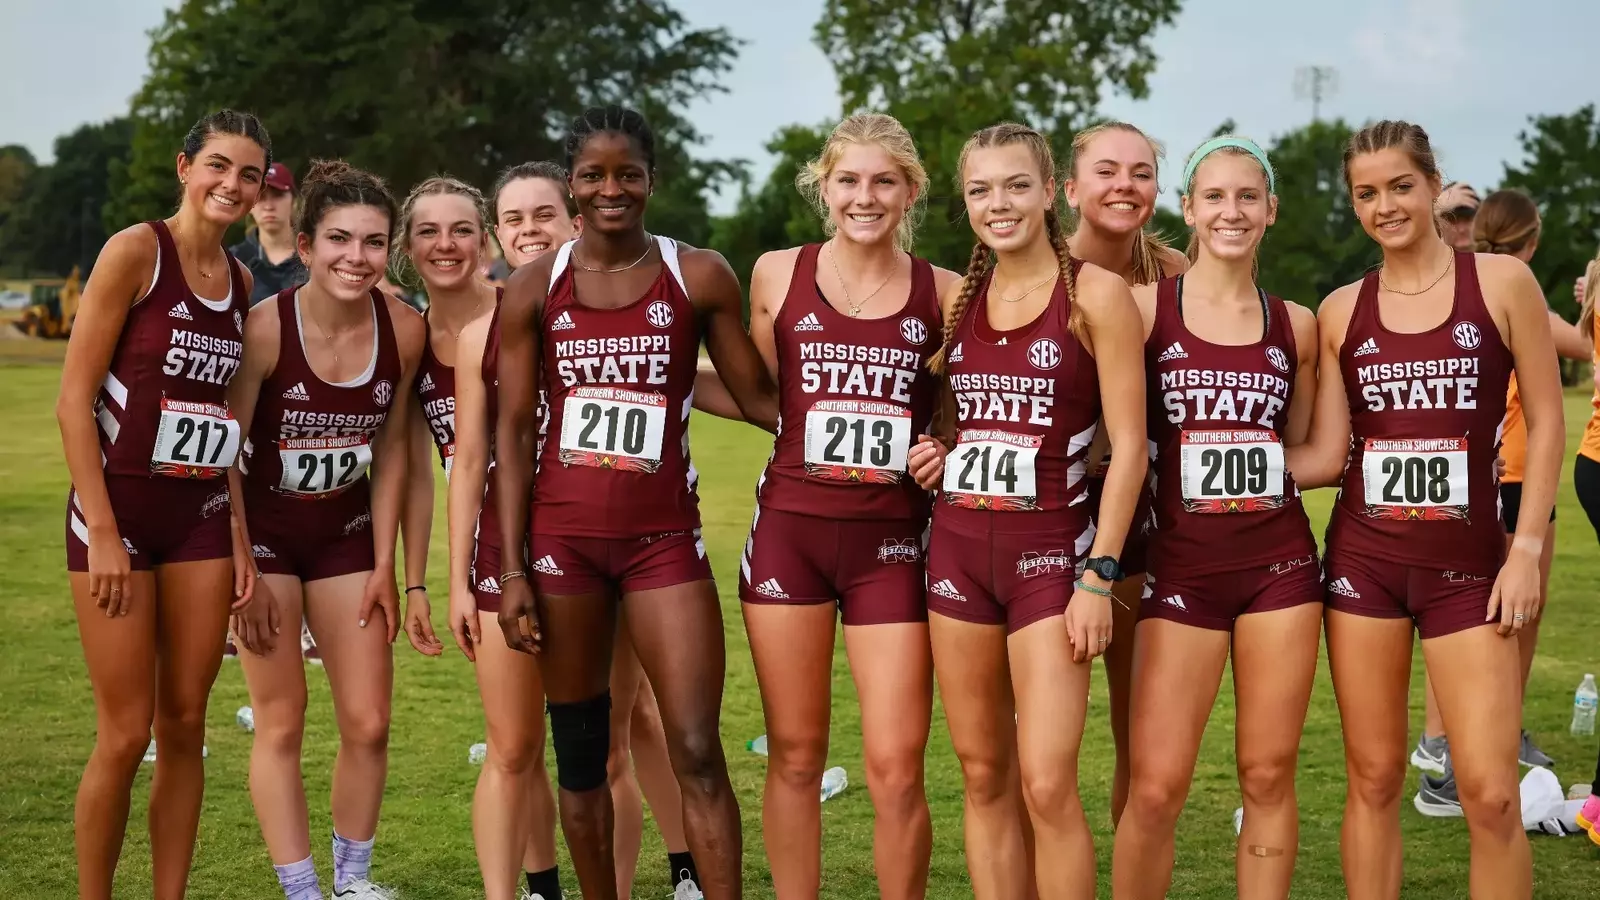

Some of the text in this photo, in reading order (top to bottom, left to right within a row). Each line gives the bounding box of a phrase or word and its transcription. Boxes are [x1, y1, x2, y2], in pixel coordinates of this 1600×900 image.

[168, 311, 194, 320] adidas
[648, 302, 672, 326] SEC
[552, 322, 576, 330] adidas
[794, 323, 823, 332] adidas
[901, 318, 926, 344] SEC
[1454, 323, 1479, 348] SEC
[170, 328, 242, 358] MISSISSIPP
[556, 335, 670, 357] MISSISSIPPI
[1030, 340, 1059, 368] SEC
[1354, 347, 1380, 358] adidas
[800, 342, 921, 370] MISSISSIPPI
[1158, 352, 1188, 362] adidas
[557, 354, 670, 387] STATE
[1358, 357, 1479, 384] MISSISSIPPI
[374, 380, 392, 405] SEC
[801, 361, 916, 404] STATE
[950, 373, 1056, 394] MISSISSIPPI
[1160, 369, 1289, 398] MISSISSIPPI
[282, 392, 310, 401] adidas
[576, 388, 659, 405] SOUTHERN SHOWCASE
[1362, 377, 1478, 412] STATE
[167, 400, 204, 414] SOUTHERN
[281, 409, 386, 427] MISSISSIPPI
[816, 401, 904, 416] SOUTHERN SHOWCASE
[956, 392, 1053, 426] STATE
[1163, 388, 1284, 430] STATE
[578, 402, 648, 454] 210
[991, 430, 1034, 447] SHOWCASE
[1189, 432, 1272, 442] SOUTHERN SHOWCASE
[170, 417, 228, 464] 217
[286, 436, 362, 448] SOUTHERN SHOWCASE
[824, 416, 892, 466] 213
[1372, 440, 1459, 450] SOUTHERN SHOWCASE
[298, 451, 358, 492] 212
[958, 446, 1018, 493] 214
[1201, 446, 1268, 496] 209
[1382, 456, 1450, 504] 208
[886, 546, 913, 554] STATE
[532, 563, 564, 576] adidas
[1026, 557, 1060, 568] STATE
[756, 585, 790, 598] adidas
[930, 586, 967, 602] adidas
[1328, 585, 1360, 598] adidas
